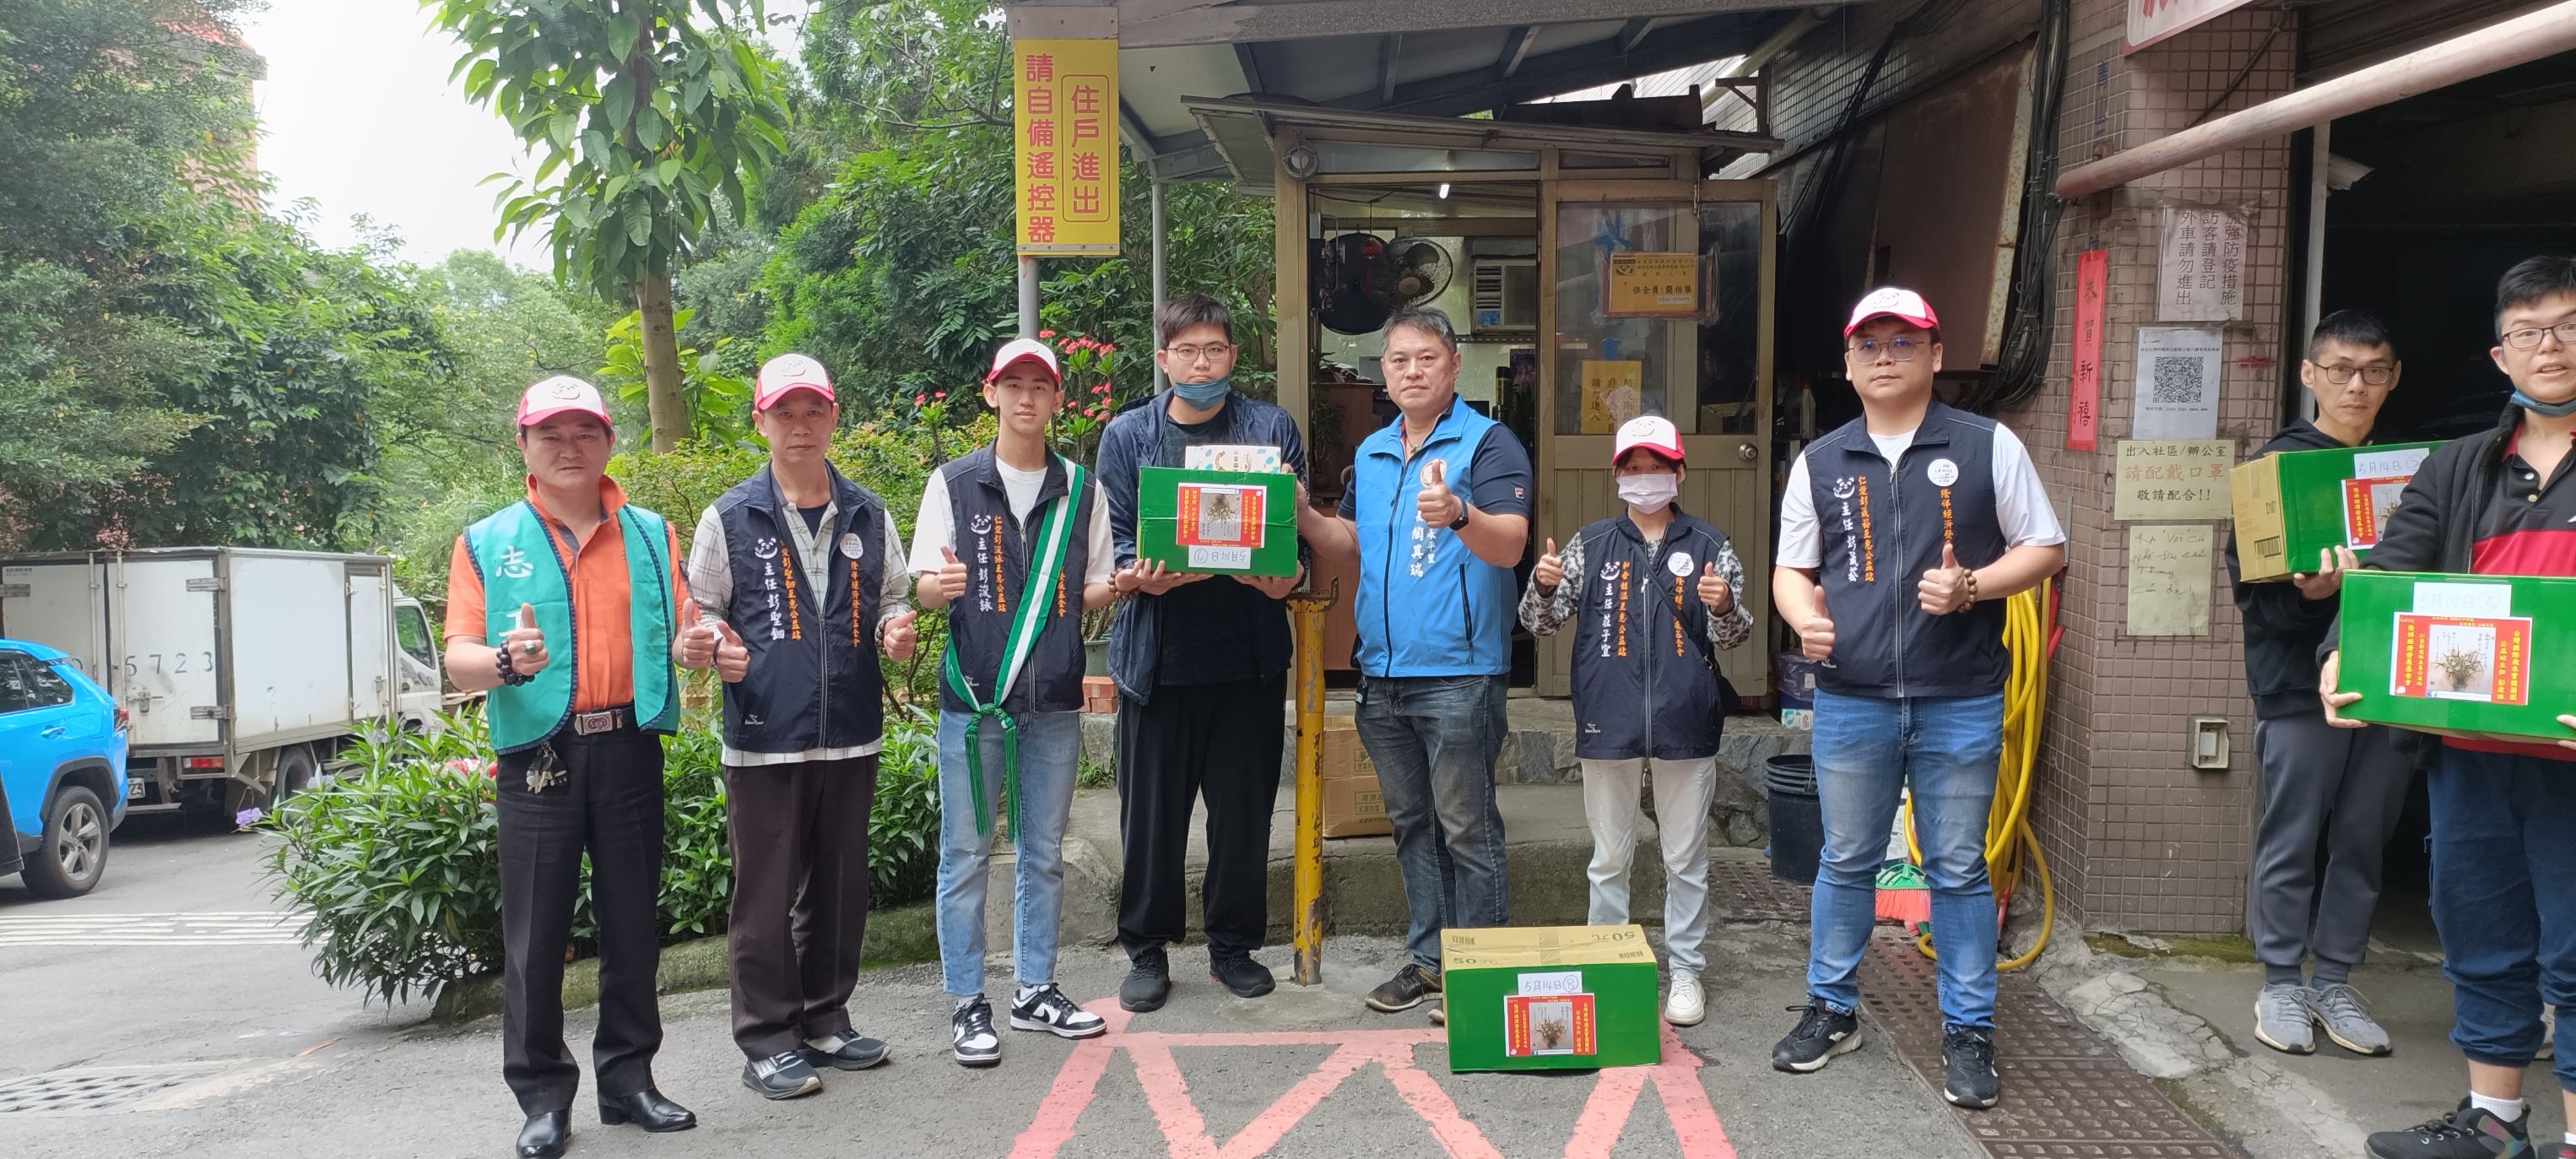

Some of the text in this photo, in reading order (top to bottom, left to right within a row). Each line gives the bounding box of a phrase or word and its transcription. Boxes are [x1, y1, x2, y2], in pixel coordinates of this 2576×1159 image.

[1026, 53, 1055, 243] 請自備遙控器
[1071, 85, 1100, 214] 住戶進出
[2176, 209, 2196, 305] 外車請勿進出
[2200, 209, 2219, 289] 訪客請登記
[2124, 463, 2225, 481] 請配戴口罩
[2125, 445, 2227, 457] 出入社區/辦公室
[2137, 489, 2211, 501] 敬請配合!!
